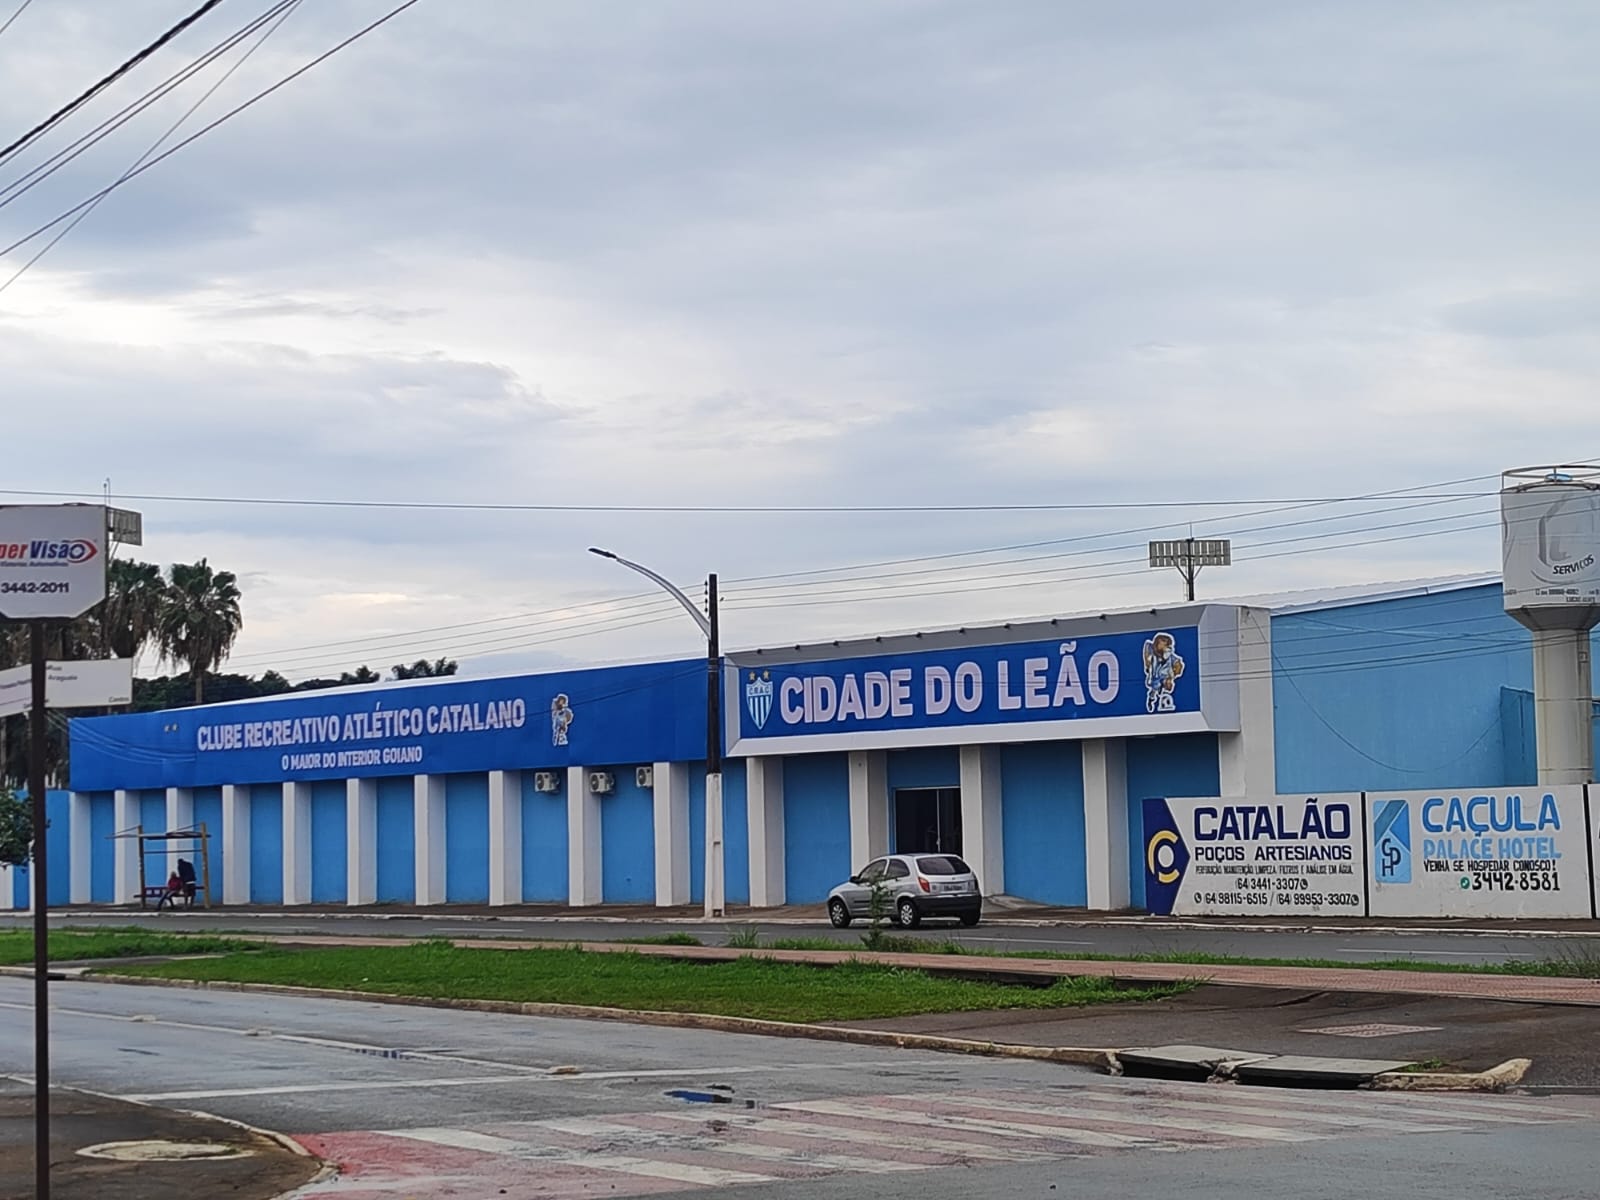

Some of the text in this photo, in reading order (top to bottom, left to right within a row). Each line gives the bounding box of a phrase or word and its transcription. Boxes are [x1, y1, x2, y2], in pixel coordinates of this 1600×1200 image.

[1, 582, 69, 594] 3442-2011
[780, 640, 1119, 725] CIDADE DO LEÃO
[197, 699, 525, 751] CLUBE RECREATIVO ATLÉTICO CATALANO
[281, 745, 423, 770] O MAIOR DO INTERIOR GOIANO
[1194, 797, 1350, 841] CATALÃO
[1421, 794, 1561, 837] CAÇULA
[1195, 845, 1352, 863] POÇOS ARTESIANOS
[1423, 836, 1562, 860] PALACE HOTEL
[1423, 859, 1450, 872] VENHA
[1453, 859, 1464, 872] SE
[1467, 859, 1509, 872] HOSPEDAR
